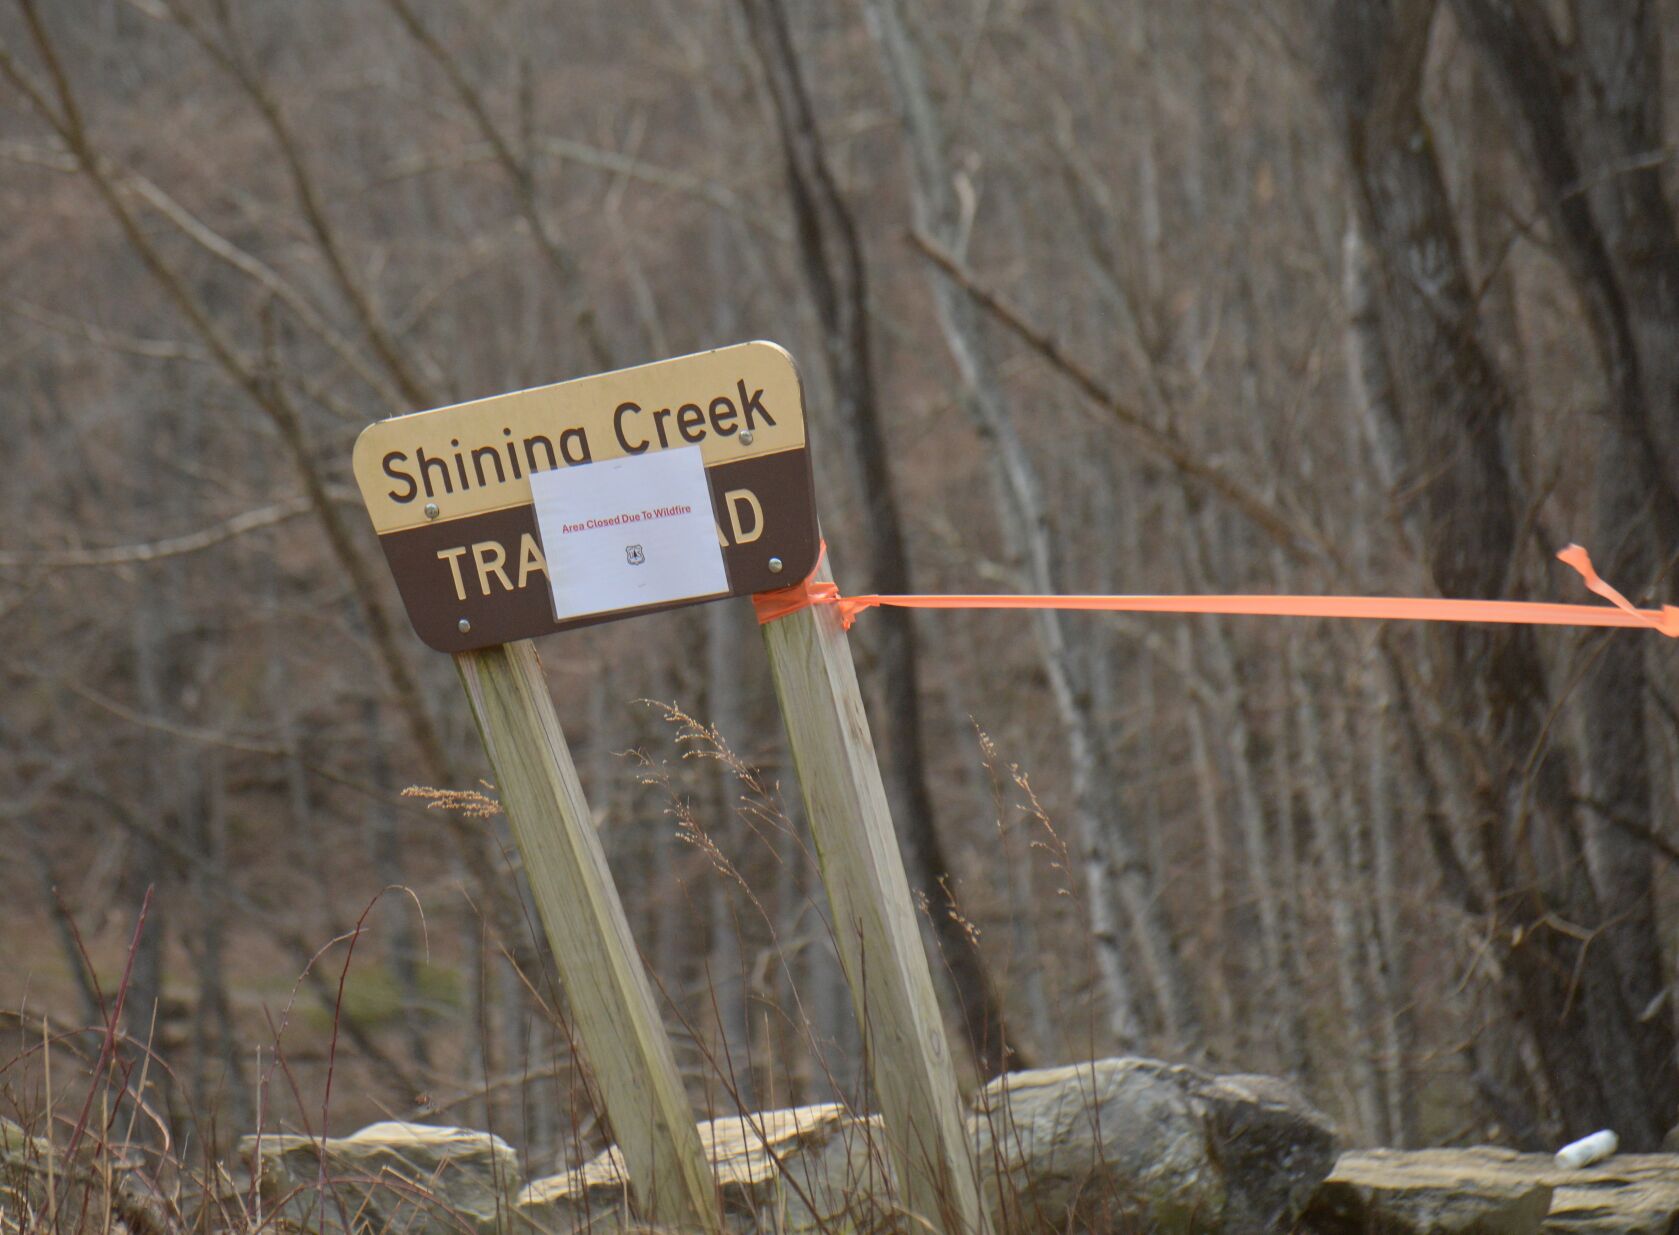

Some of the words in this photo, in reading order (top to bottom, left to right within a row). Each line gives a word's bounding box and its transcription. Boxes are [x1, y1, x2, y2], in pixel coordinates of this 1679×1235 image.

[613, 378, 777, 456] Creek
[562, 523, 585, 534] Area
[586, 515, 620, 529] Closed
[621, 512, 641, 524] Due
[641, 510, 653, 520] To
[653, 504, 692, 518] Wildfire
